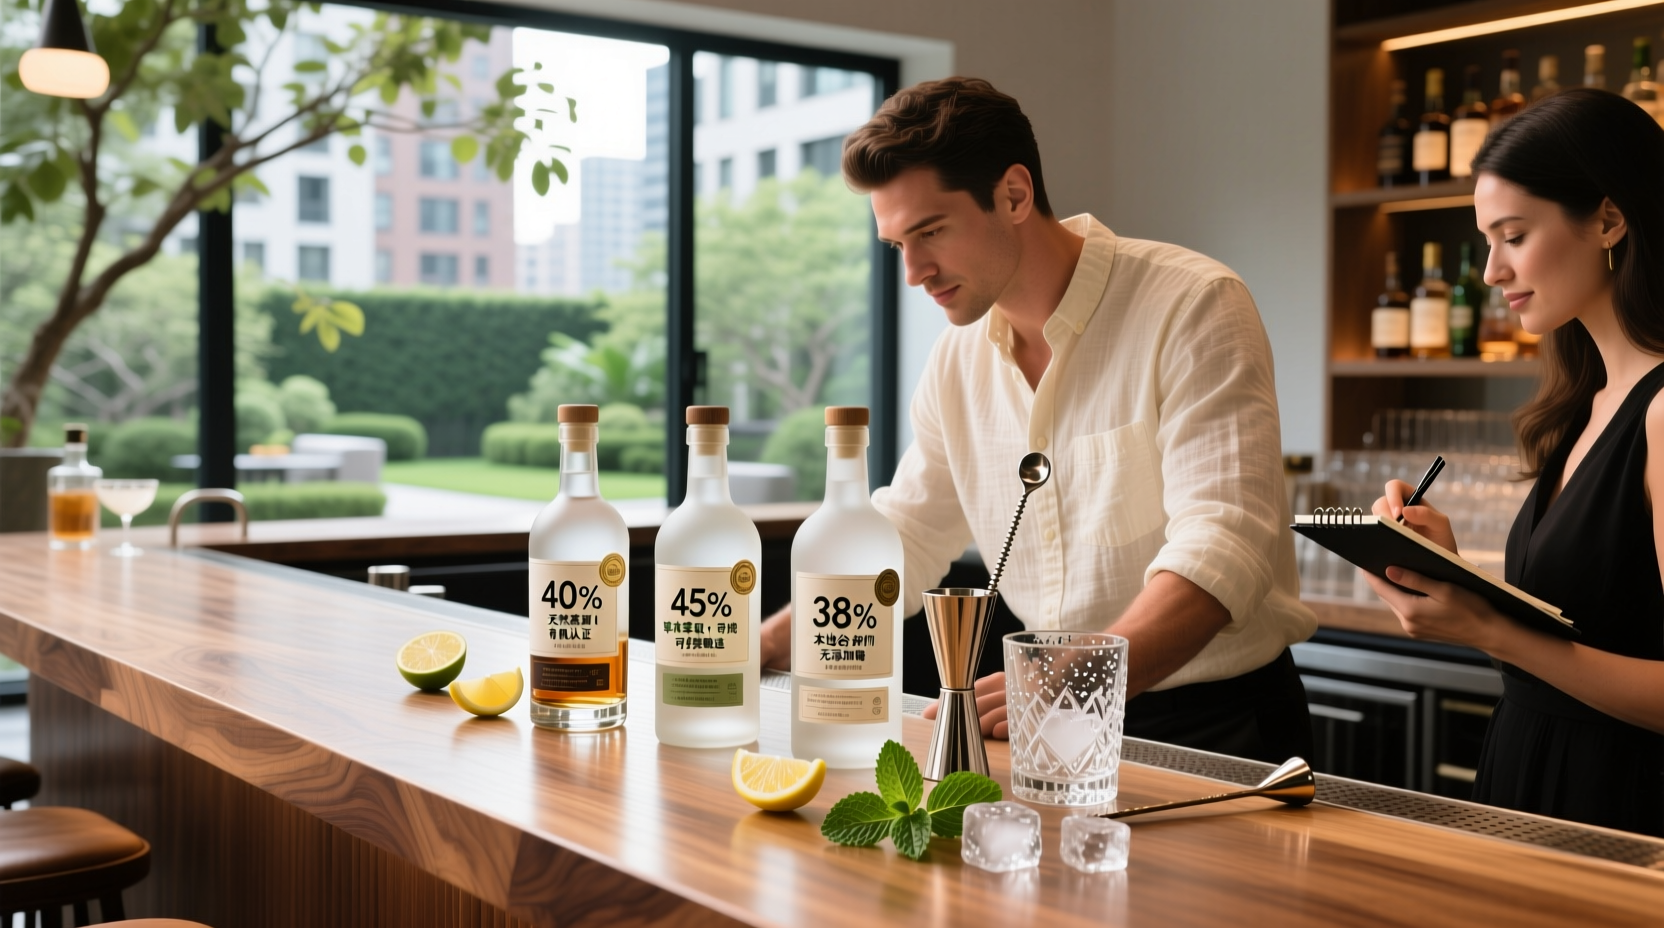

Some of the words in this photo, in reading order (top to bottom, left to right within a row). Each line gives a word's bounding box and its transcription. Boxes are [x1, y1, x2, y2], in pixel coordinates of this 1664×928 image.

[541, 580, 603, 610] 40%
[670, 587, 732, 618] 45%
[812, 595, 877, 630] 38%
